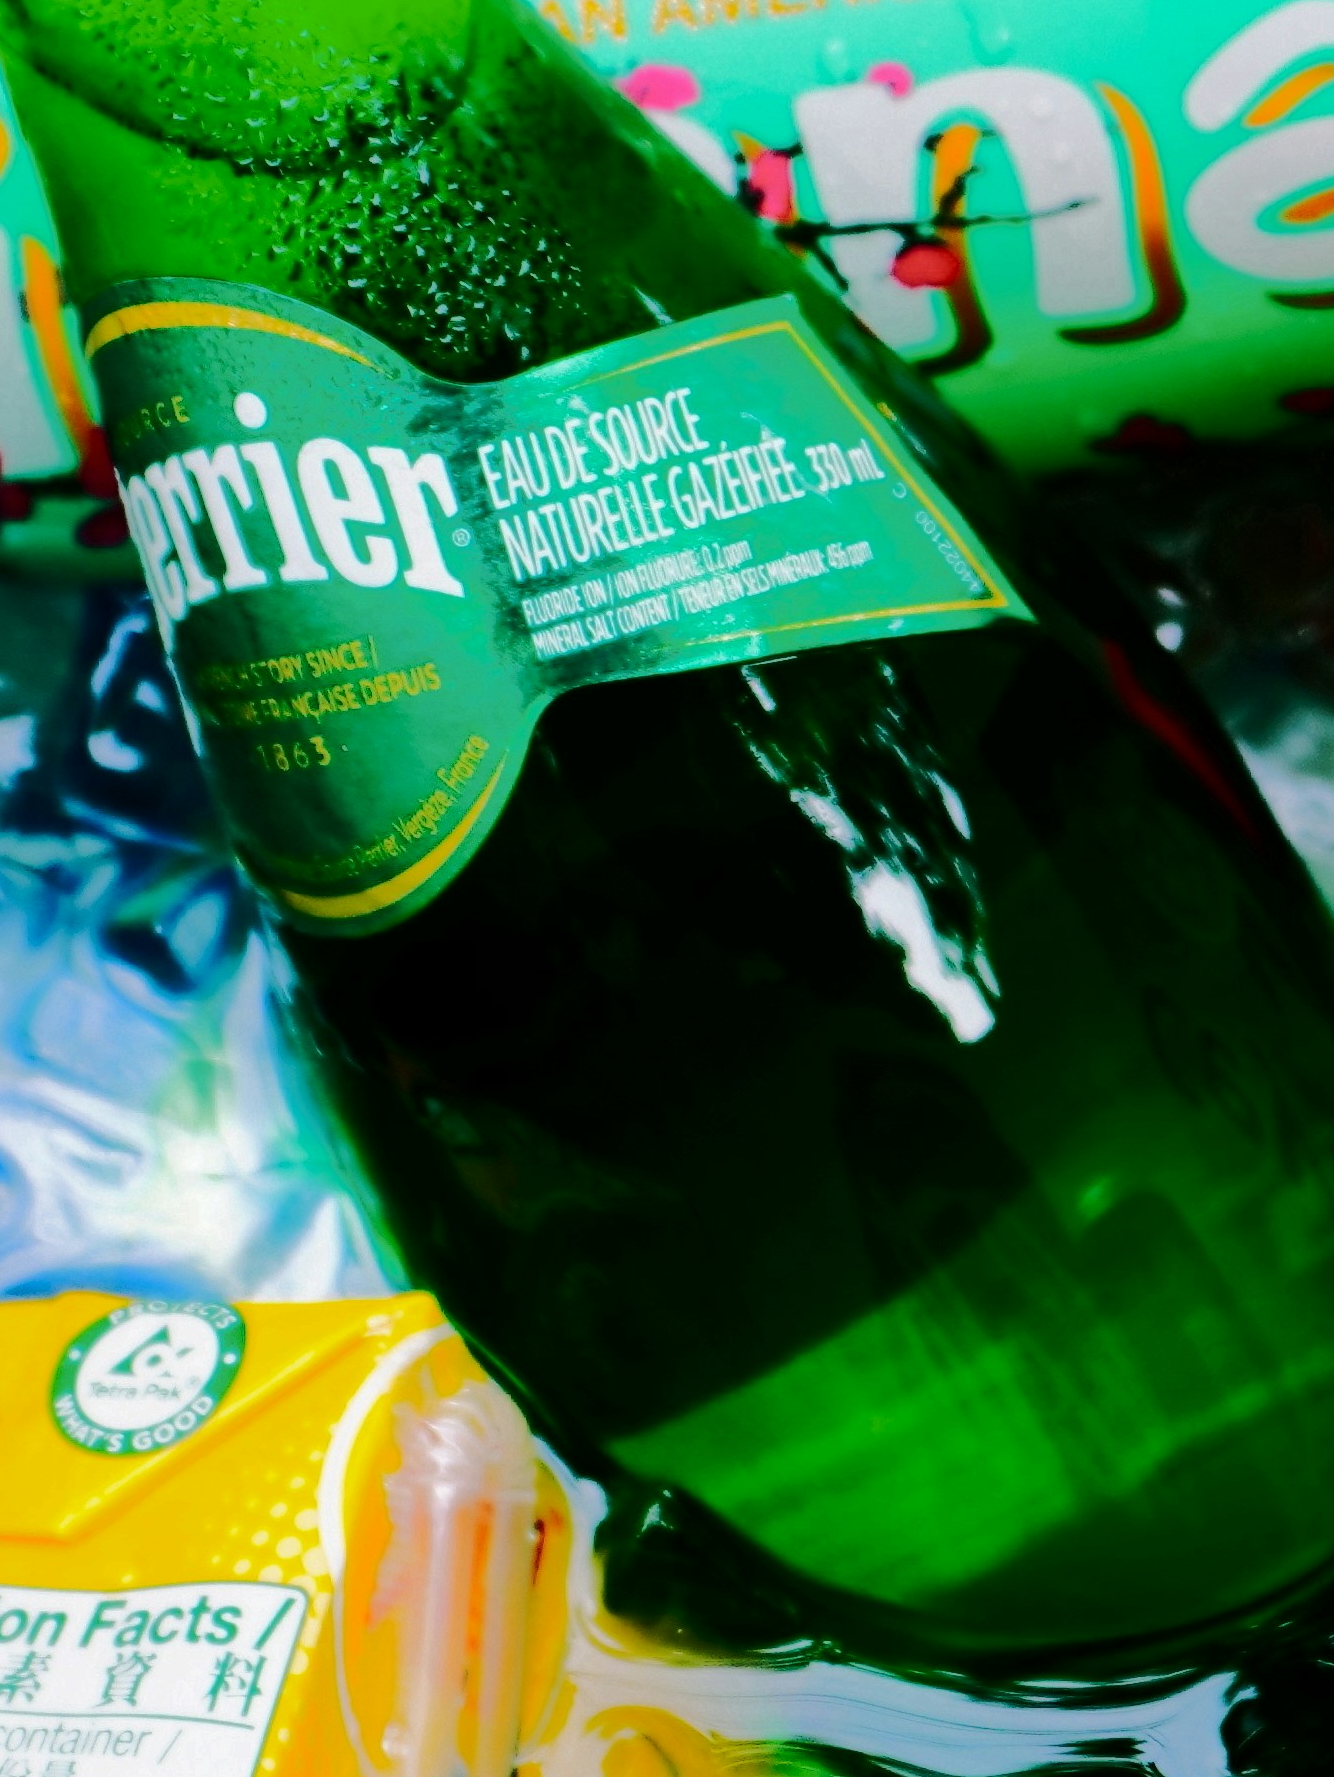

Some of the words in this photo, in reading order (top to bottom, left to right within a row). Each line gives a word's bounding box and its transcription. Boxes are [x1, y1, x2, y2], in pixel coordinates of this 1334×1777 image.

[478, 430, 551, 510] EAU
[544, 420, 594, 490] DE
[588, 387, 709, 477] SOURCE
[126, 392, 465, 621] errier
[499, 473, 675, 582] NATURELLE
[804, 445, 850, 492] 330
[521, 588, 583, 629] FLUORIDE
[581, 586, 604, 613] ION
[530, 621, 590, 661] MINERAL
[589, 613, 618, 649] SALT
[617, 597, 669, 641] CONTENT
[307, 640, 368, 680] SINCE
[362, 663, 440, 706] DEPUIS
[448, 734, 489, 795] France
[90, 1382, 138, 1398] Tetra
[55, 1395, 124, 1453] WHAT'S
[131, 1396, 213, 1451] GOOD
[77, 1590, 242, 1649] Facts
